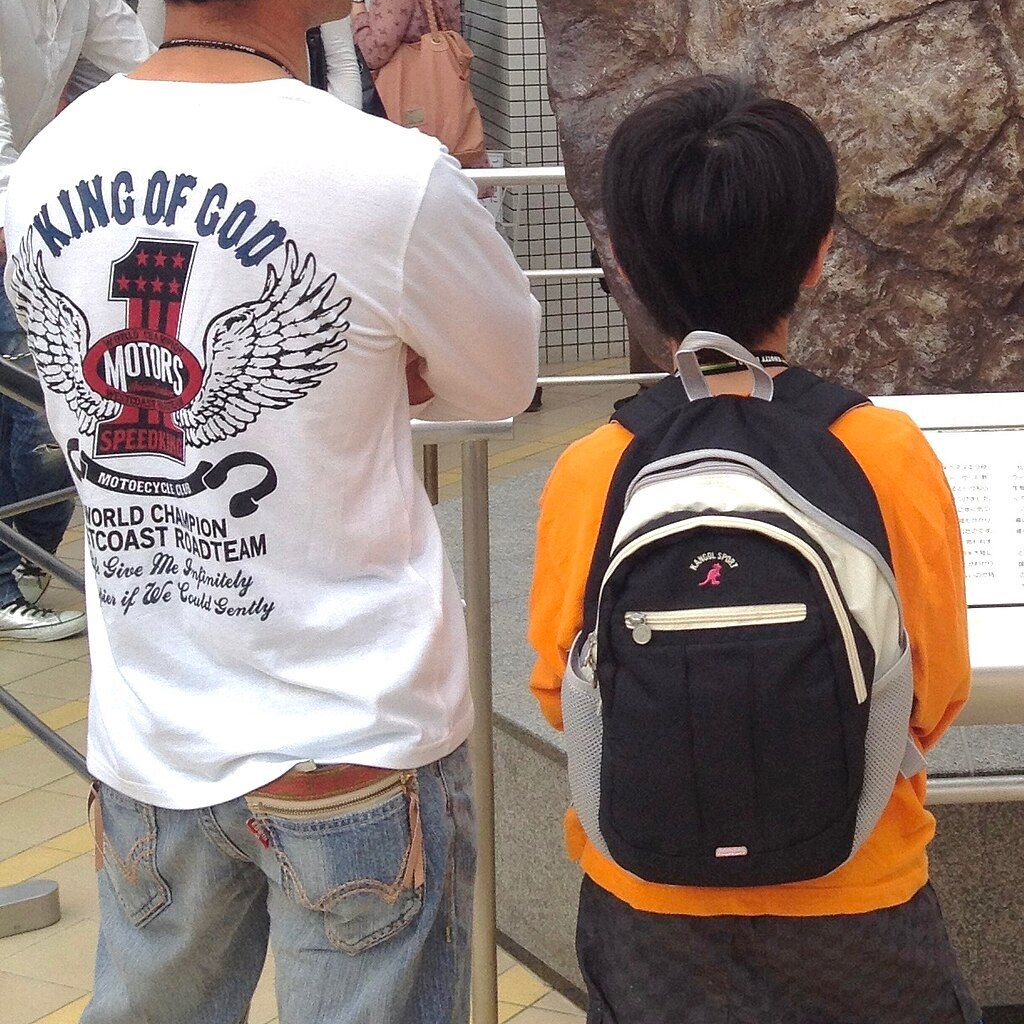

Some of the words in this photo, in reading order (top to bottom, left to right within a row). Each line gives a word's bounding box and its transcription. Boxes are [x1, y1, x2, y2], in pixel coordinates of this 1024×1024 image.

[33, 171, 135, 257] KING
[143, 170, 197, 226] OF
[195, 183, 287, 267] GOD
[104, 342, 183, 396] MOTORS
[98, 472, 174, 494] MOTOECYCLE
[175, 482, 192, 496] CLUB
[151, 504, 227, 538] CHAMPION
[175, 528, 267, 562] ROADTEAM
[690, 552, 716, 571] KANGOL
[717, 552, 739, 568] SPORT
[103, 556, 143, 578] Give
[150, 552, 179, 576] Me
[183, 558, 253, 597] Infinitely
[121, 586, 139, 615] if
[143, 581, 173, 605] We
[178, 582, 212, 611] Could
[214, 597, 275, 621] Gently
